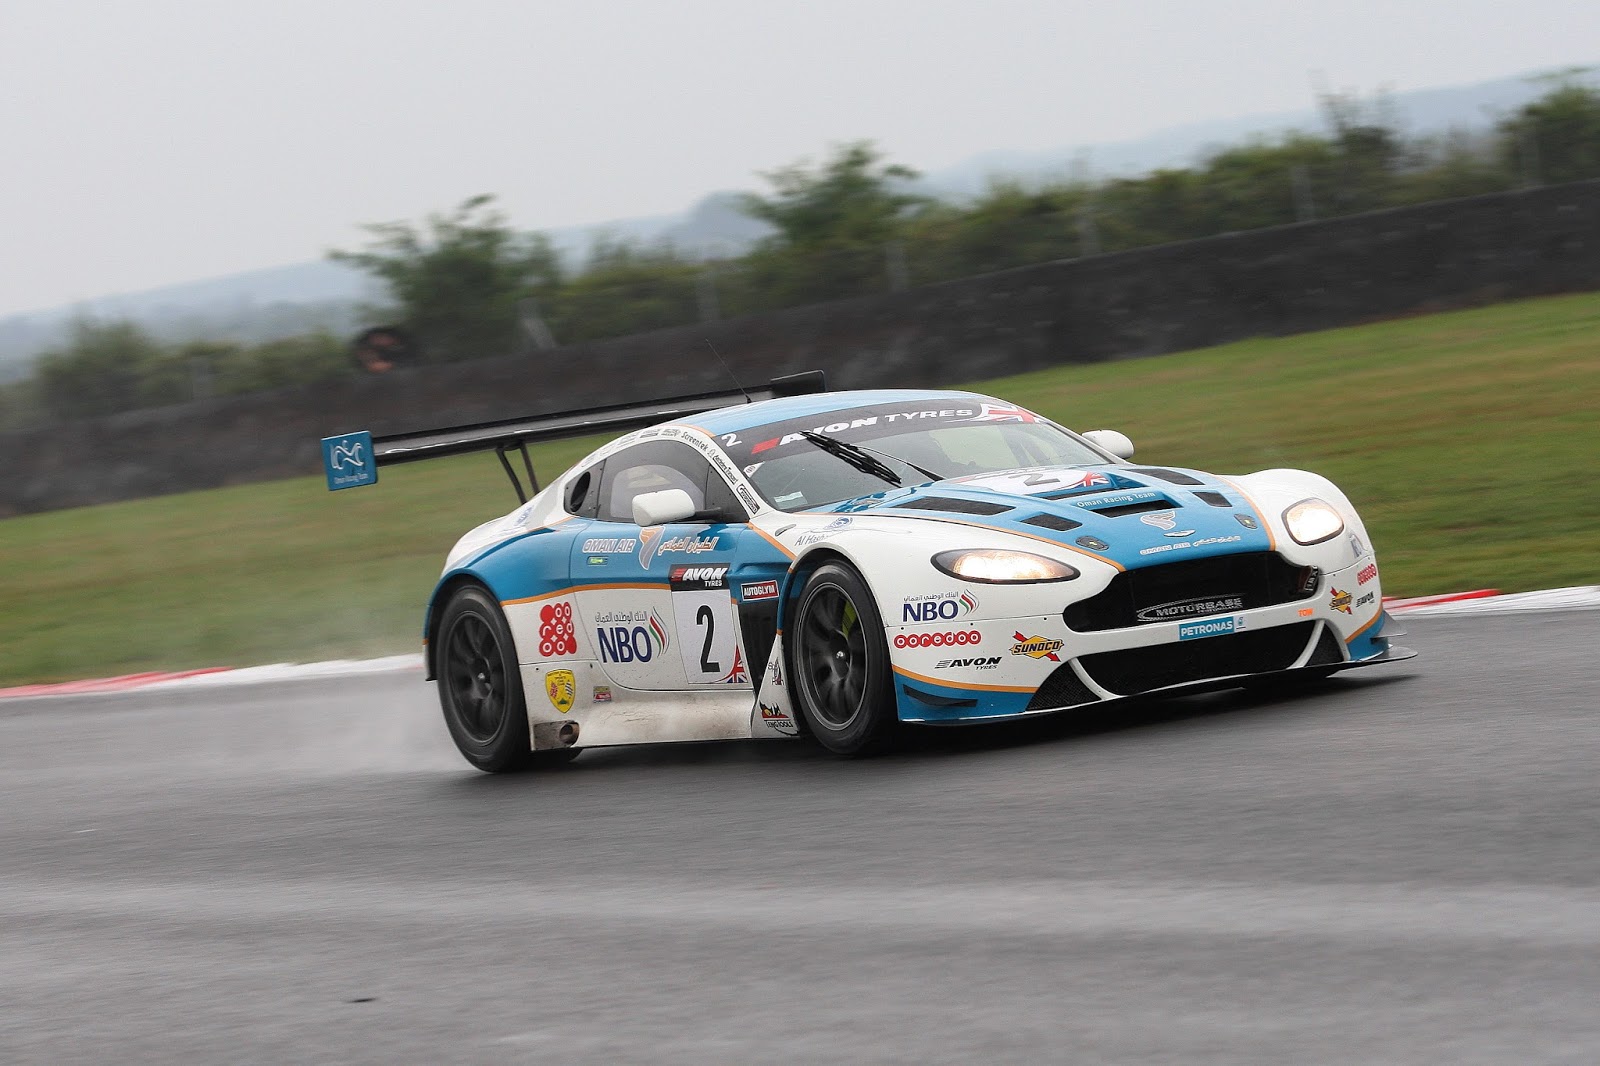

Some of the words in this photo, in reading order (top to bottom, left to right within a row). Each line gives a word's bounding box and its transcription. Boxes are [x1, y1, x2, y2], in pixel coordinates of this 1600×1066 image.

[885, 409, 973, 422] TYRES
[681, 431, 709, 452] Screentek
[721, 433, 743, 448] 2
[1008, 473, 1061, 487] 2
[1077, 499, 1102, 508] Oman
[1103, 495, 1133, 503] Racing
[582, 539, 616, 553] OMAN
[615, 539, 636, 553] AIR
[682, 567, 728, 581] AVON
[704, 580, 723, 588] TYRES
[743, 584, 776, 597] AUTOGLYM
[902, 599, 959, 622] NBO
[1156, 597, 1243, 616] MOTORBASE
[1297, 608, 1313, 617] TOW
[1181, 620, 1233, 636] PETRONAS
[597, 626, 652, 663] NBO
[696, 605, 720, 673] 2
[895, 631, 980, 647] ooredoo
[1013, 640, 1062, 654] SUNOCO
[949, 656, 1002, 668] AVON
